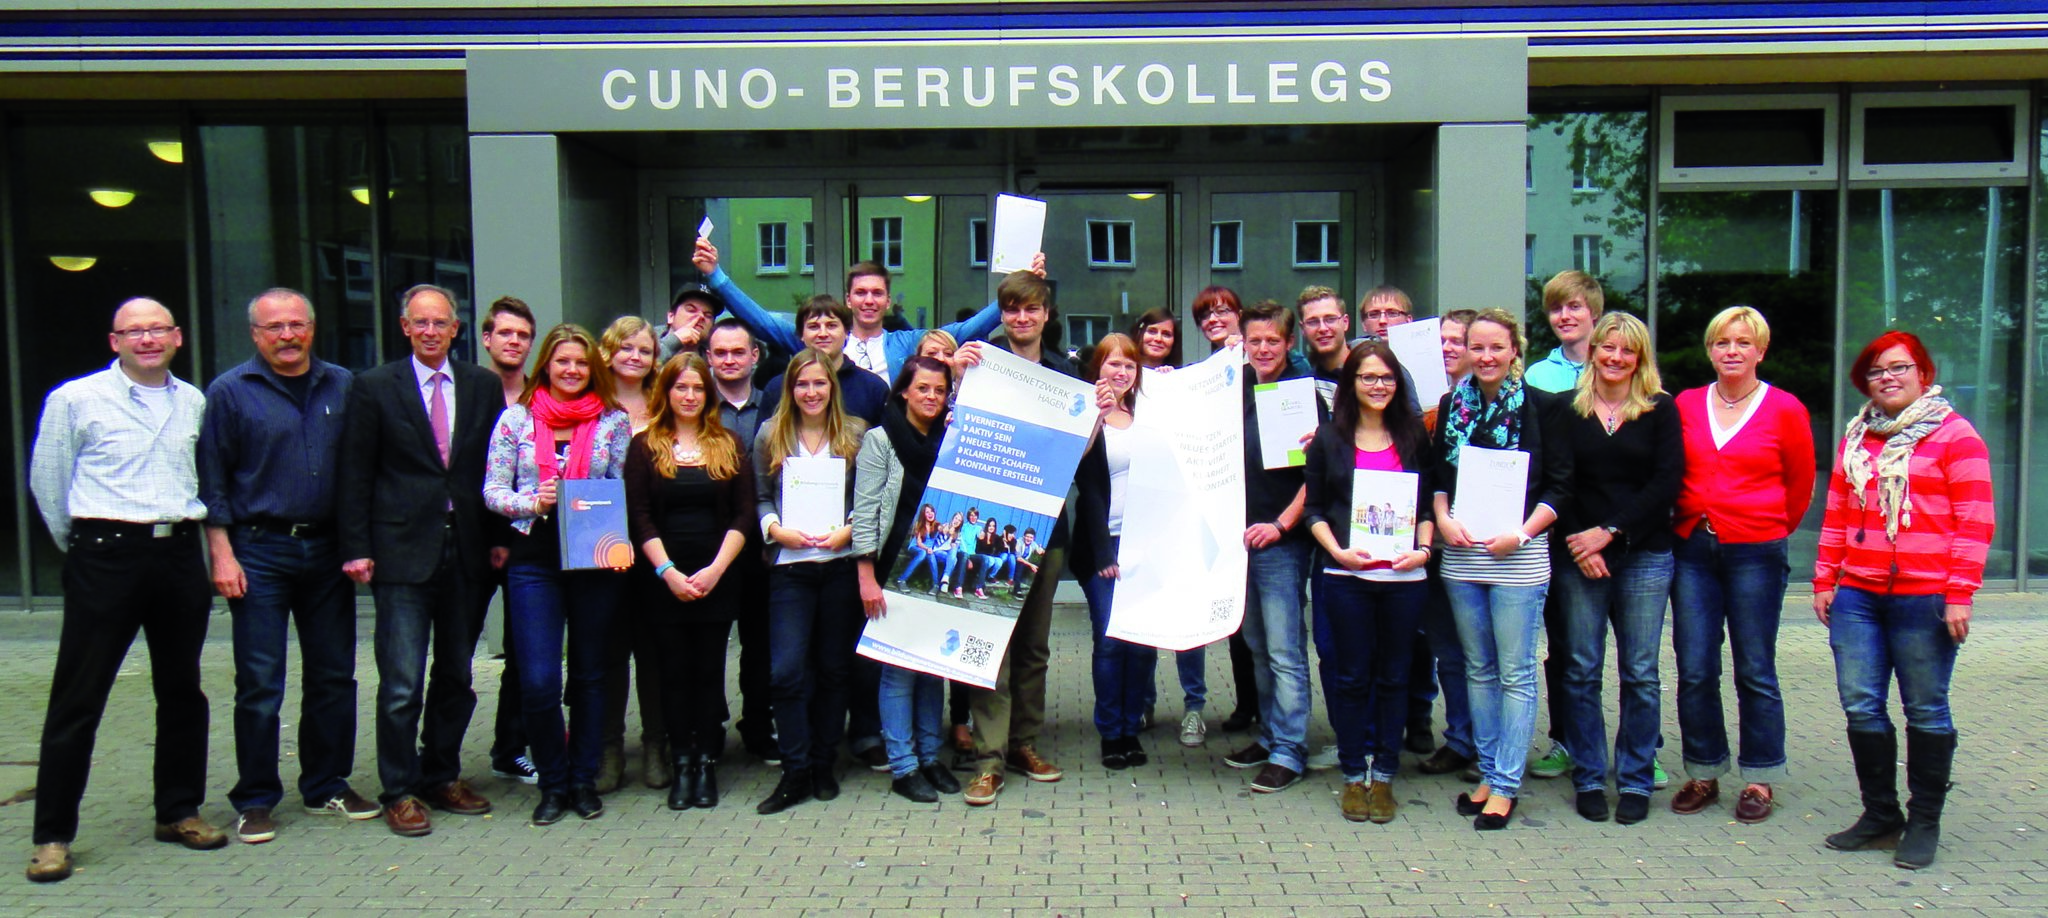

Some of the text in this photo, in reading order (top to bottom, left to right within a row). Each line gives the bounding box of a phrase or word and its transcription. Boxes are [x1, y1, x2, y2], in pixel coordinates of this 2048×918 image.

[602, 60, 1393, 110] CUNO- BERUFSKOLLEGS
[980, 359, 1071, 399] BILDUNGSNETZWERK
[1037, 393, 1067, 410] HAGEN
[968, 426, 1012, 443] AKTIV SEIN
[970, 414, 1016, 433] VERNETZEN
[966, 436, 1027, 458] NEUES STARTEN
[960, 458, 1044, 486] KONTAKTE ERSTELLEN
[963, 447, 1041, 474] KLARHEIT SCHAFFEN
